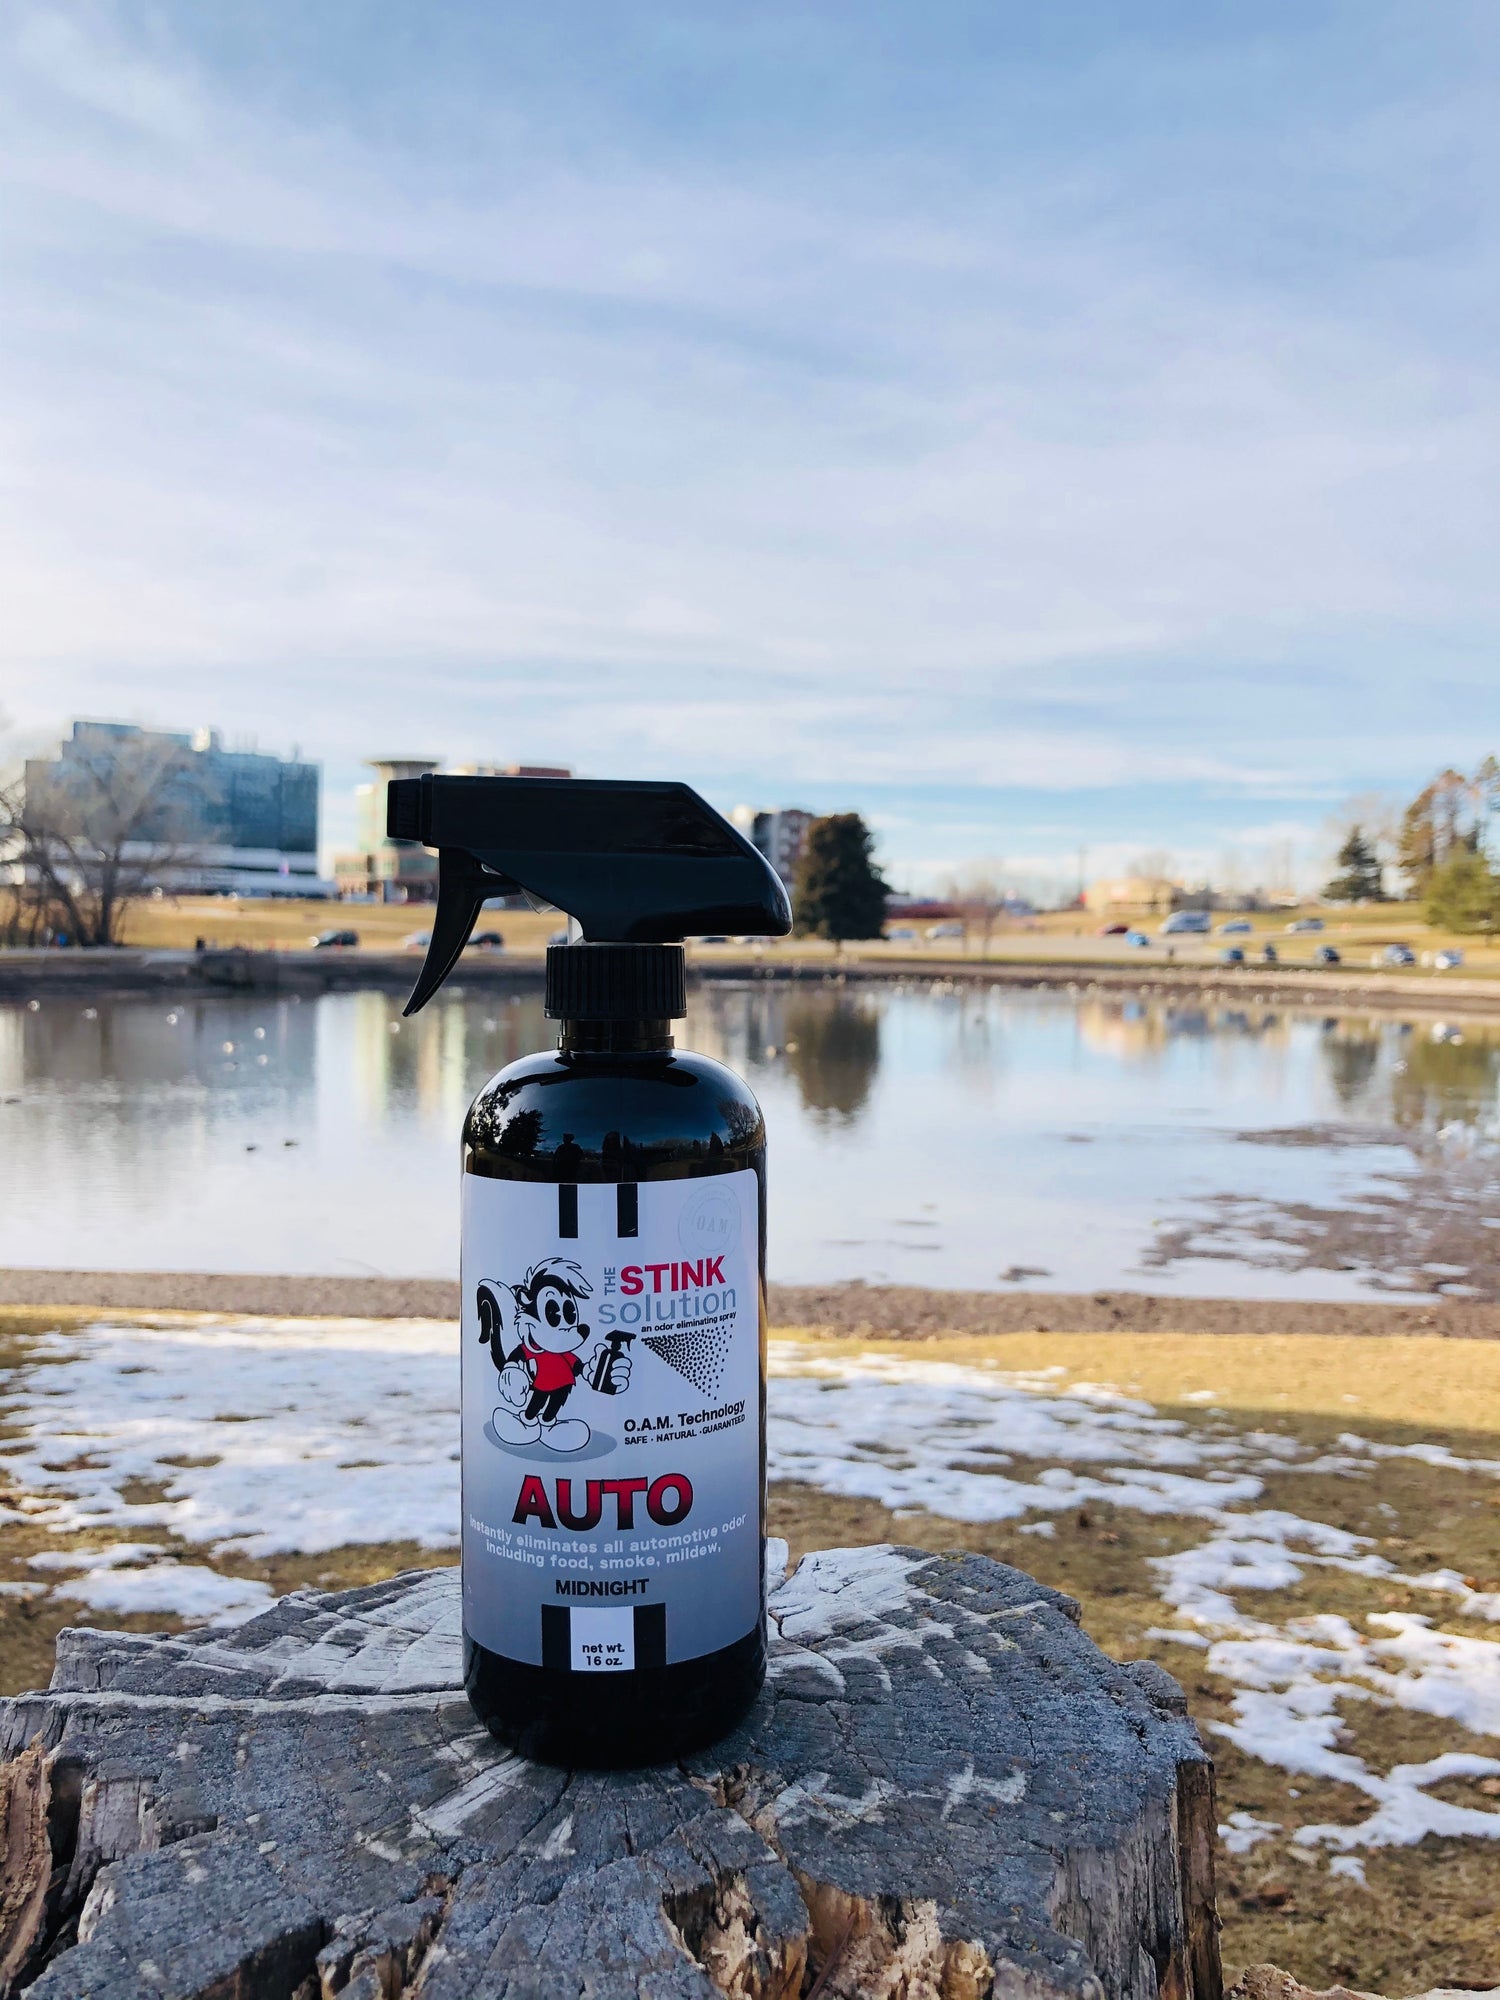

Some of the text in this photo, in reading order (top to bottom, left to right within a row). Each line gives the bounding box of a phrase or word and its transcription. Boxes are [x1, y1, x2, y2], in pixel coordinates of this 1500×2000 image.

[604, 1255, 726, 1296] THE STINK
[598, 1287, 737, 1325] solution
[641, 1311, 737, 1333] an odor eliminating spray
[624, 1399, 746, 1432] O.A.M. Technology
[624, 1435, 648, 1445] SAFE
[656, 1429, 697, 1442] NATURAL
[511, 1473, 694, 1532] AUTO
[516, 1534, 598, 1553] eliminates
[603, 1540, 624, 1553] all
[629, 1526, 718, 1552] automotive
[721, 1513, 747, 1534] odor
[486, 1539, 722, 1571] including food, smoke, mildew,
[555, 1578, 650, 1597] MIDNIGHT
[581, 1642, 626, 1654] net wt.
[586, 1655, 623, 1666] 16 oz.
